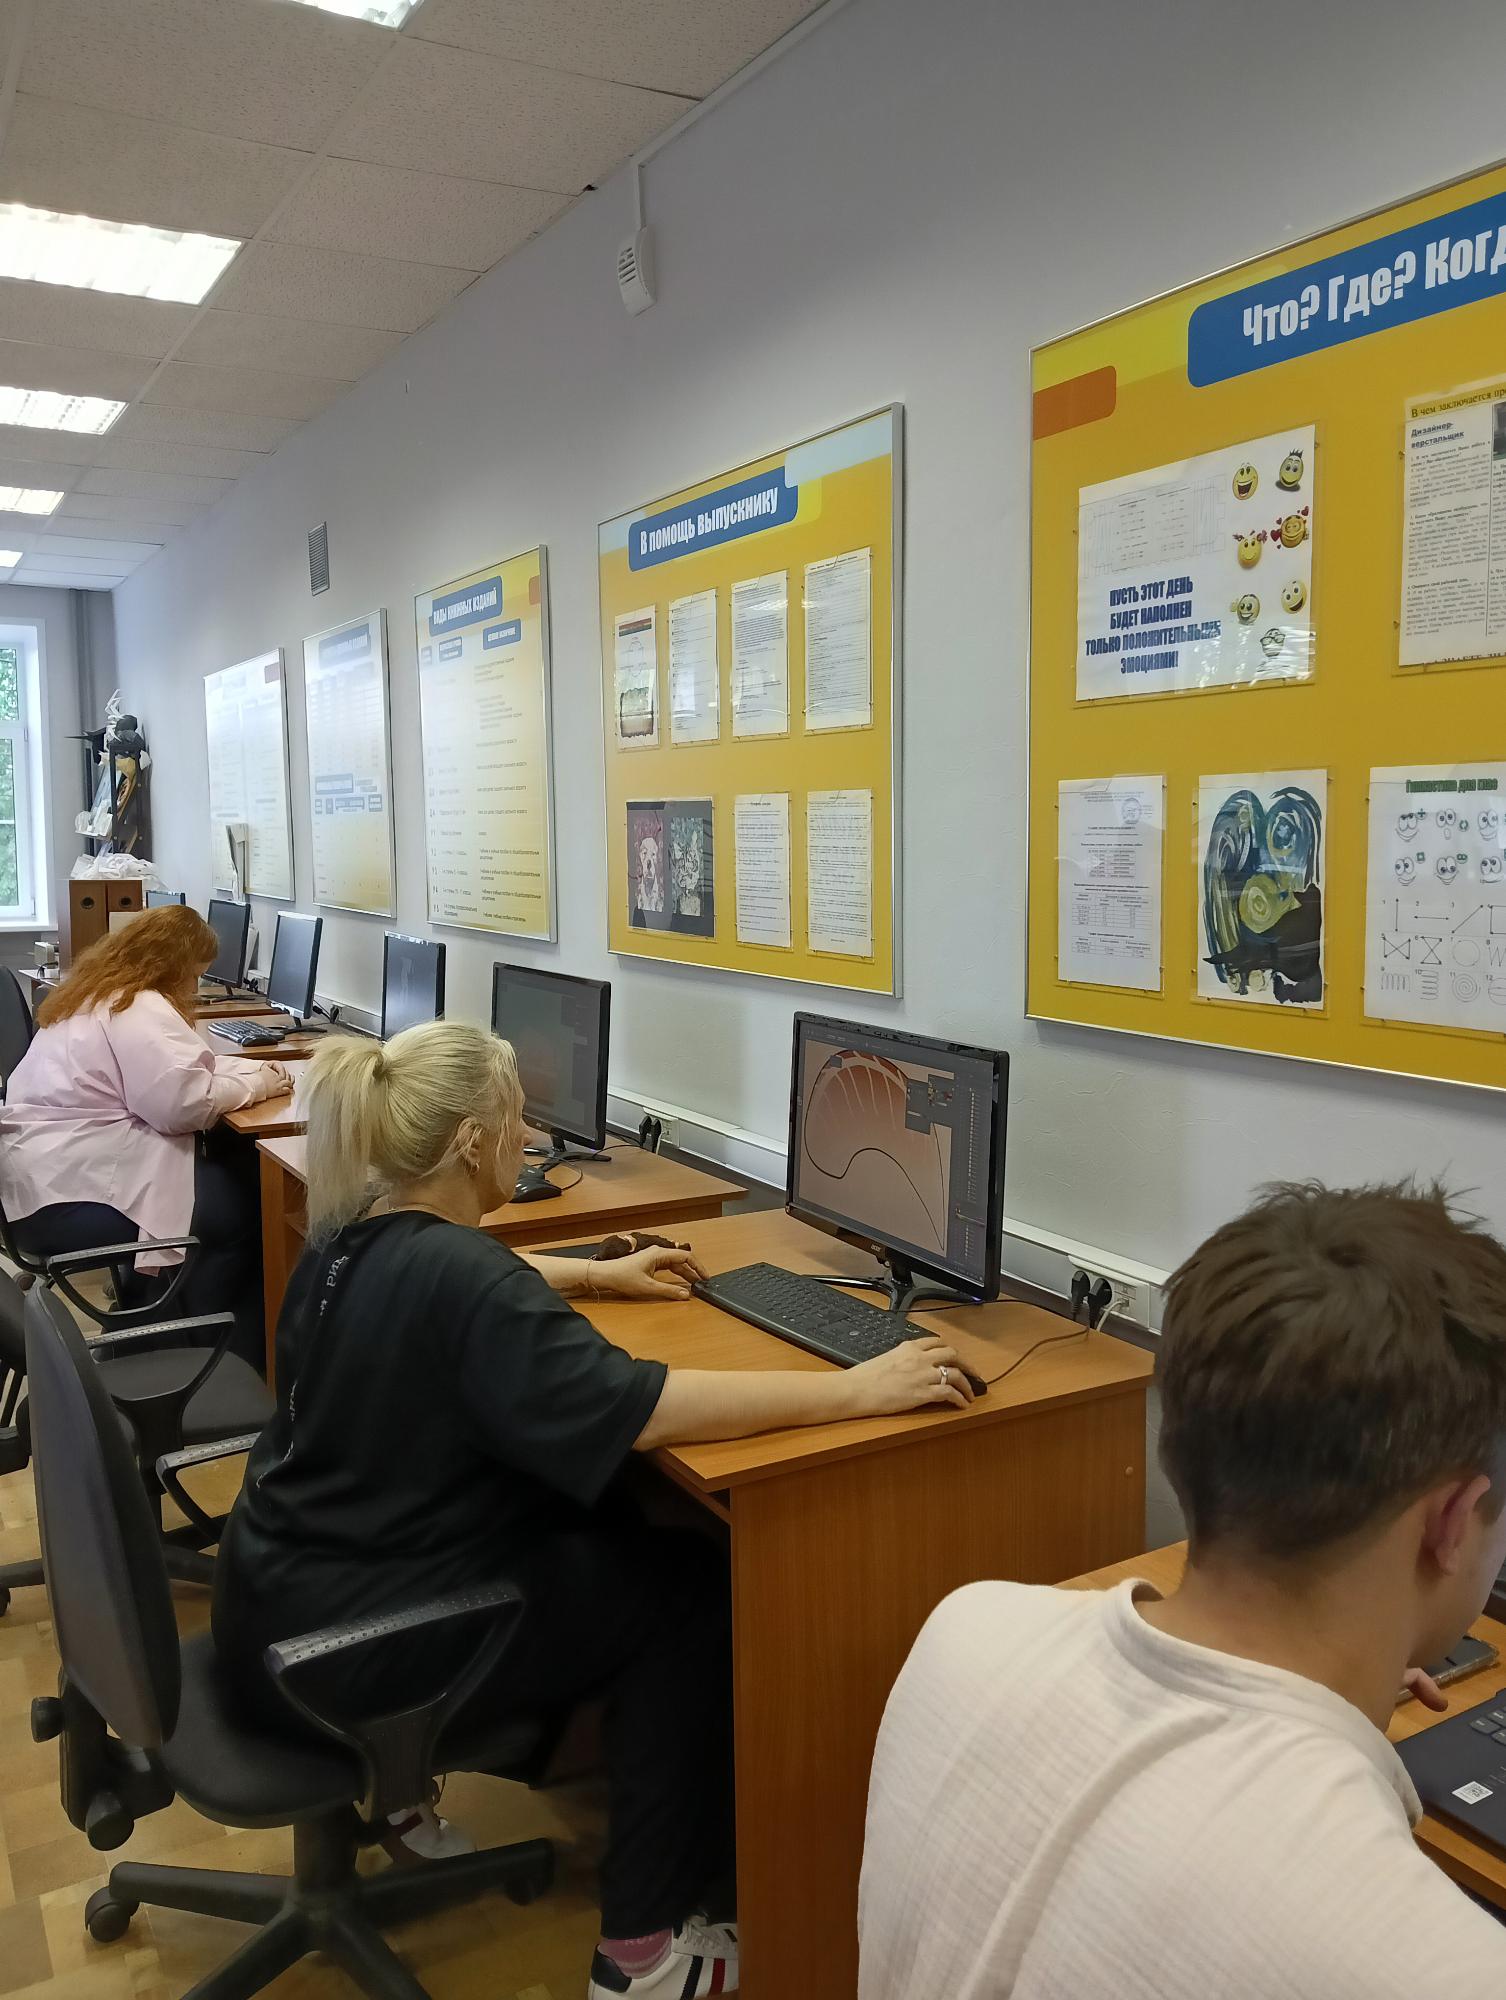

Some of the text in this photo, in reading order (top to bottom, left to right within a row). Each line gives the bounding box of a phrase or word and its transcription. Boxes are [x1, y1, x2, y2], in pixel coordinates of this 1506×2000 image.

[1243, 285, 1320, 346] Что?
[1328, 251, 1416, 323] Где?
[1411, 408, 1418, 418] В
[1420, 406, 1436, 415] чем
[1439, 392, 1492, 412] заключается
[1411, 422, 1453, 437] Дизайнер-
[1411, 432, 1464, 449] верстальщик
[640, 487, 778, 555] В помощь выпускнику
[1110, 576, 1193, 606] ПУСТЬ ЭТОТ ДЕНЬ
[1110, 600, 1192, 630] БУДЕТ НАПОЛНЕН
[1086, 635, 1121, 656] ТОЛЬКО
[1120, 651, 1179, 674] ЭМОЦИЯМИ!
